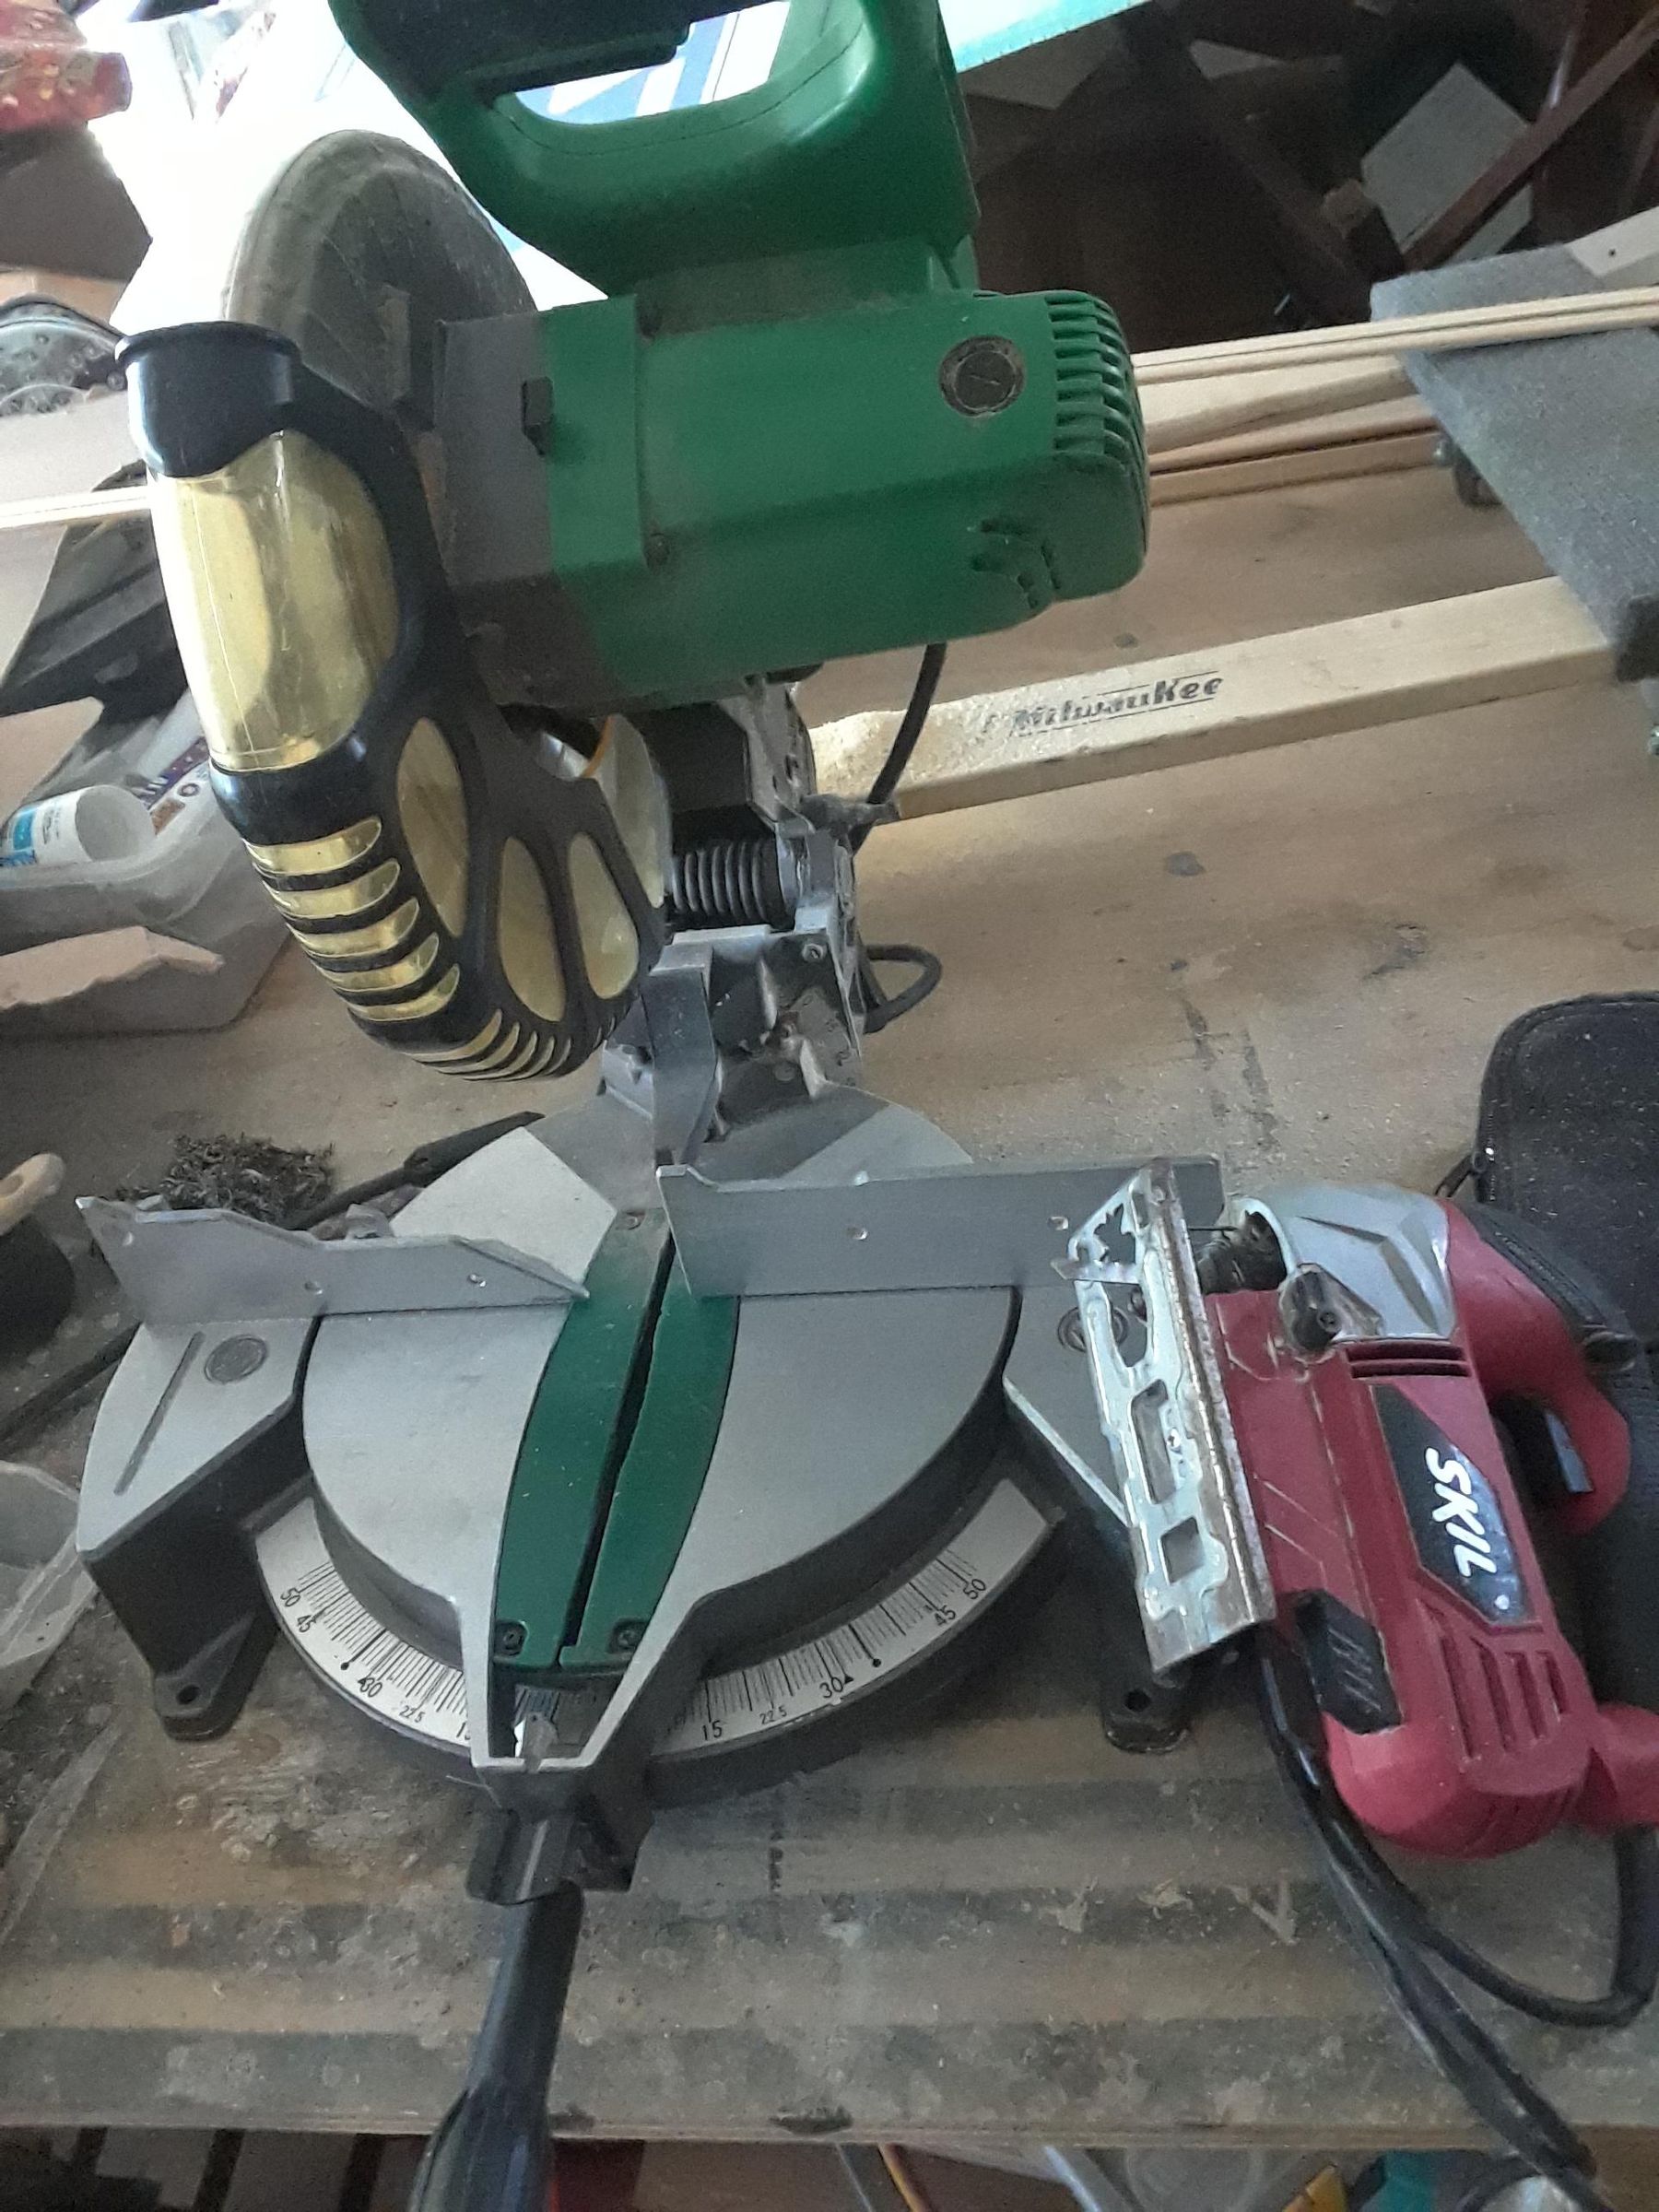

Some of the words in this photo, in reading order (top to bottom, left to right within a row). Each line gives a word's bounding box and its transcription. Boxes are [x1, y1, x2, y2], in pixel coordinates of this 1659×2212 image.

[1426, 1447, 1497, 1577] SKIL
[280, 1587, 300, 1607] 50
[297, 1614, 317, 1633] 45
[359, 1677, 383, 1698] 30
[701, 1720, 723, 1741] 15
[818, 1677, 844, 1700] 30
[934, 1604, 957, 1627] 45
[962, 1578, 986, 1600] 50
